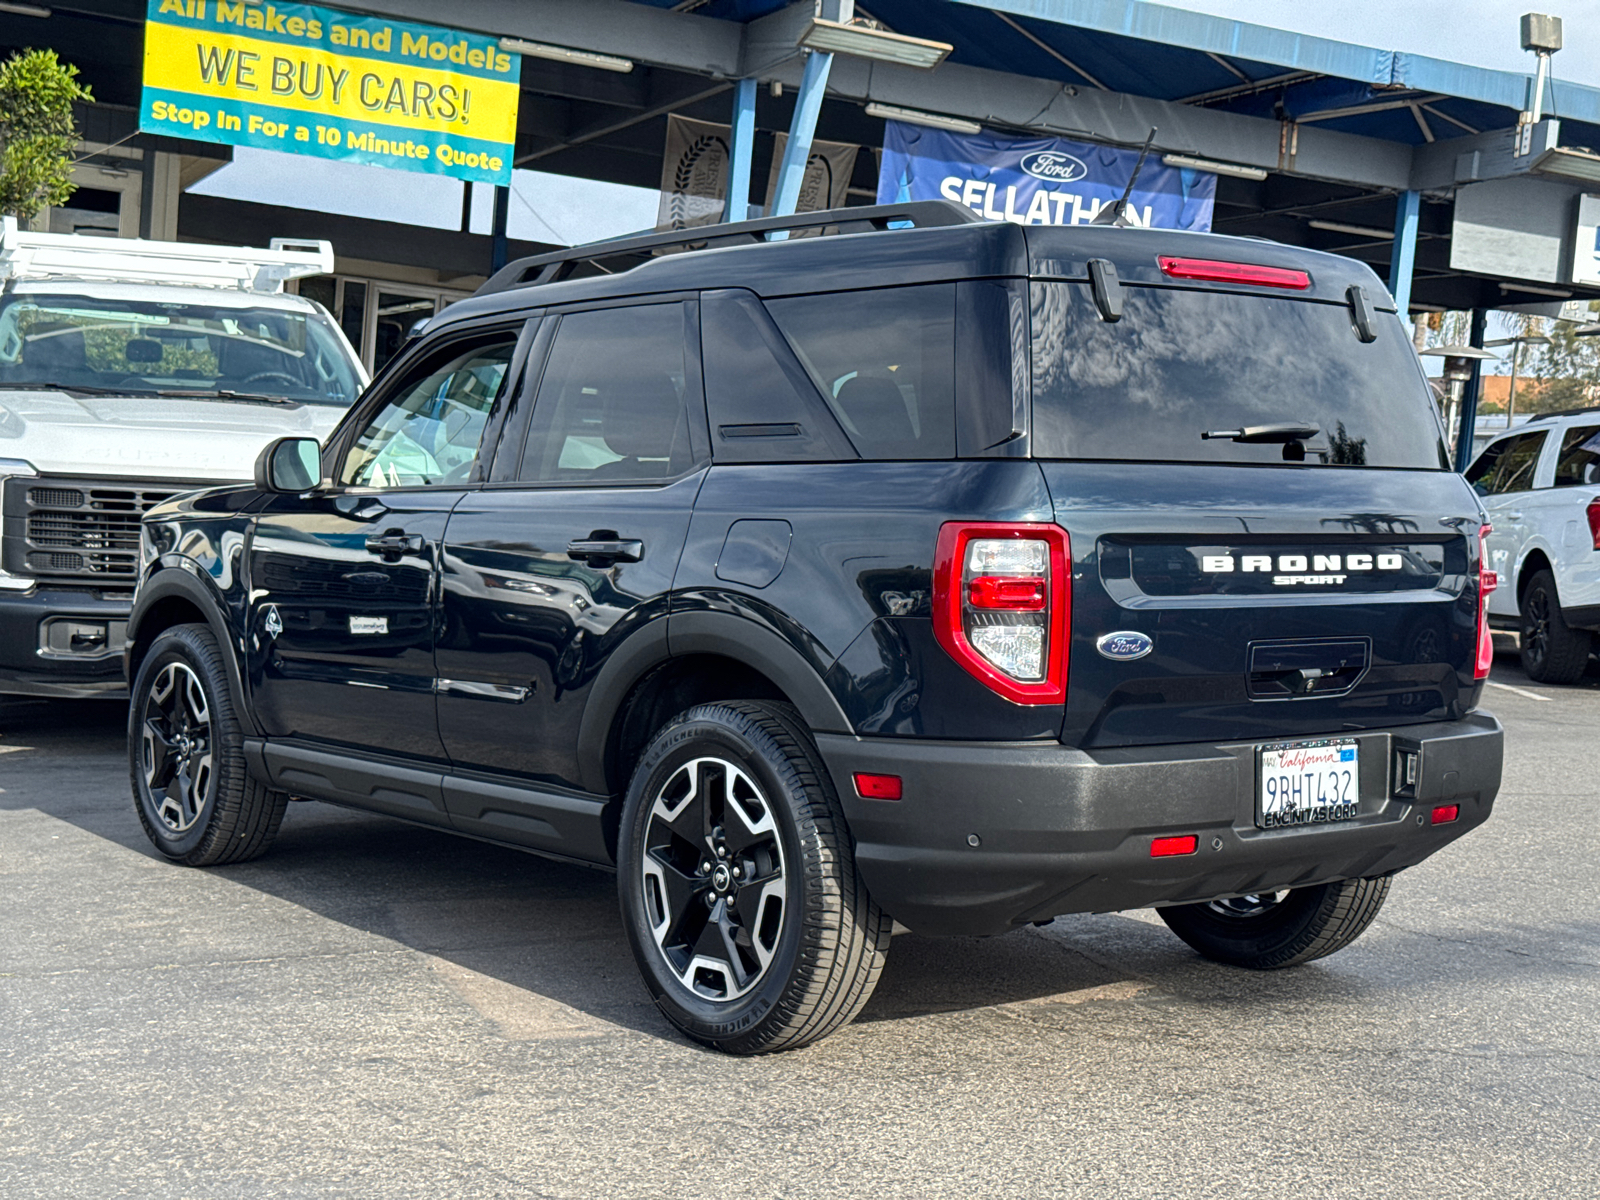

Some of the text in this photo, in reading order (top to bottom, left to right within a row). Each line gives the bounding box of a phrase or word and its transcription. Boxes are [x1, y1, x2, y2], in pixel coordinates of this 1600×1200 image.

[158, 0, 511, 73] All Makes and Models
[197, 43, 471, 124] WE BUY CARS!
[151, 101, 503, 171] Stop In For a 10 Minute Quote
[1030, 153, 1077, 179] Ford
[1202, 554, 1403, 573] BRONCO
[1271, 574, 1348, 586] SPORT
[1279, 749, 1340, 772] California
[1264, 804, 1358, 827] ENCINITAS FORD
